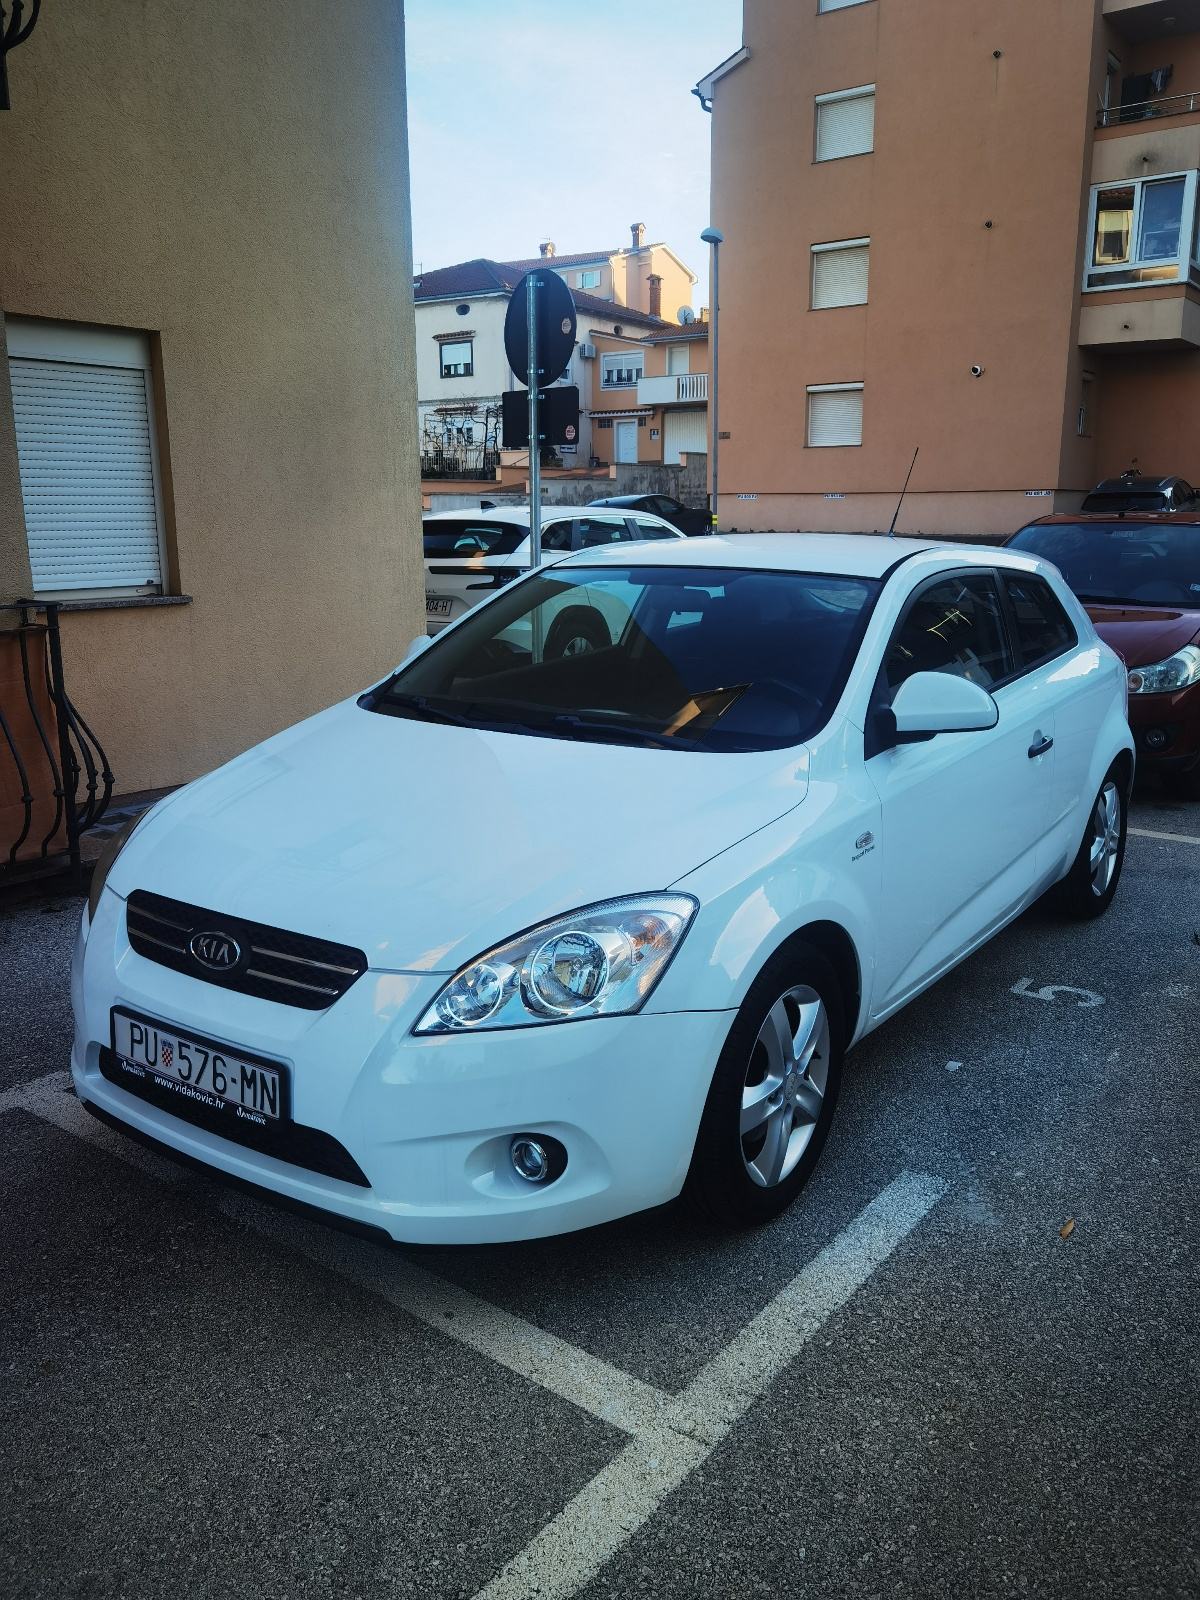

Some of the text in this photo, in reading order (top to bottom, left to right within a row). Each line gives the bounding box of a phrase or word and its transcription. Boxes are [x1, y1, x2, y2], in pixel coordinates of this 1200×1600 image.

[199, 937, 229, 964] KIA
[129, 1021, 277, 1115] PU 576-MN
[154, 1074, 226, 1110] www.vidakovic.hr
